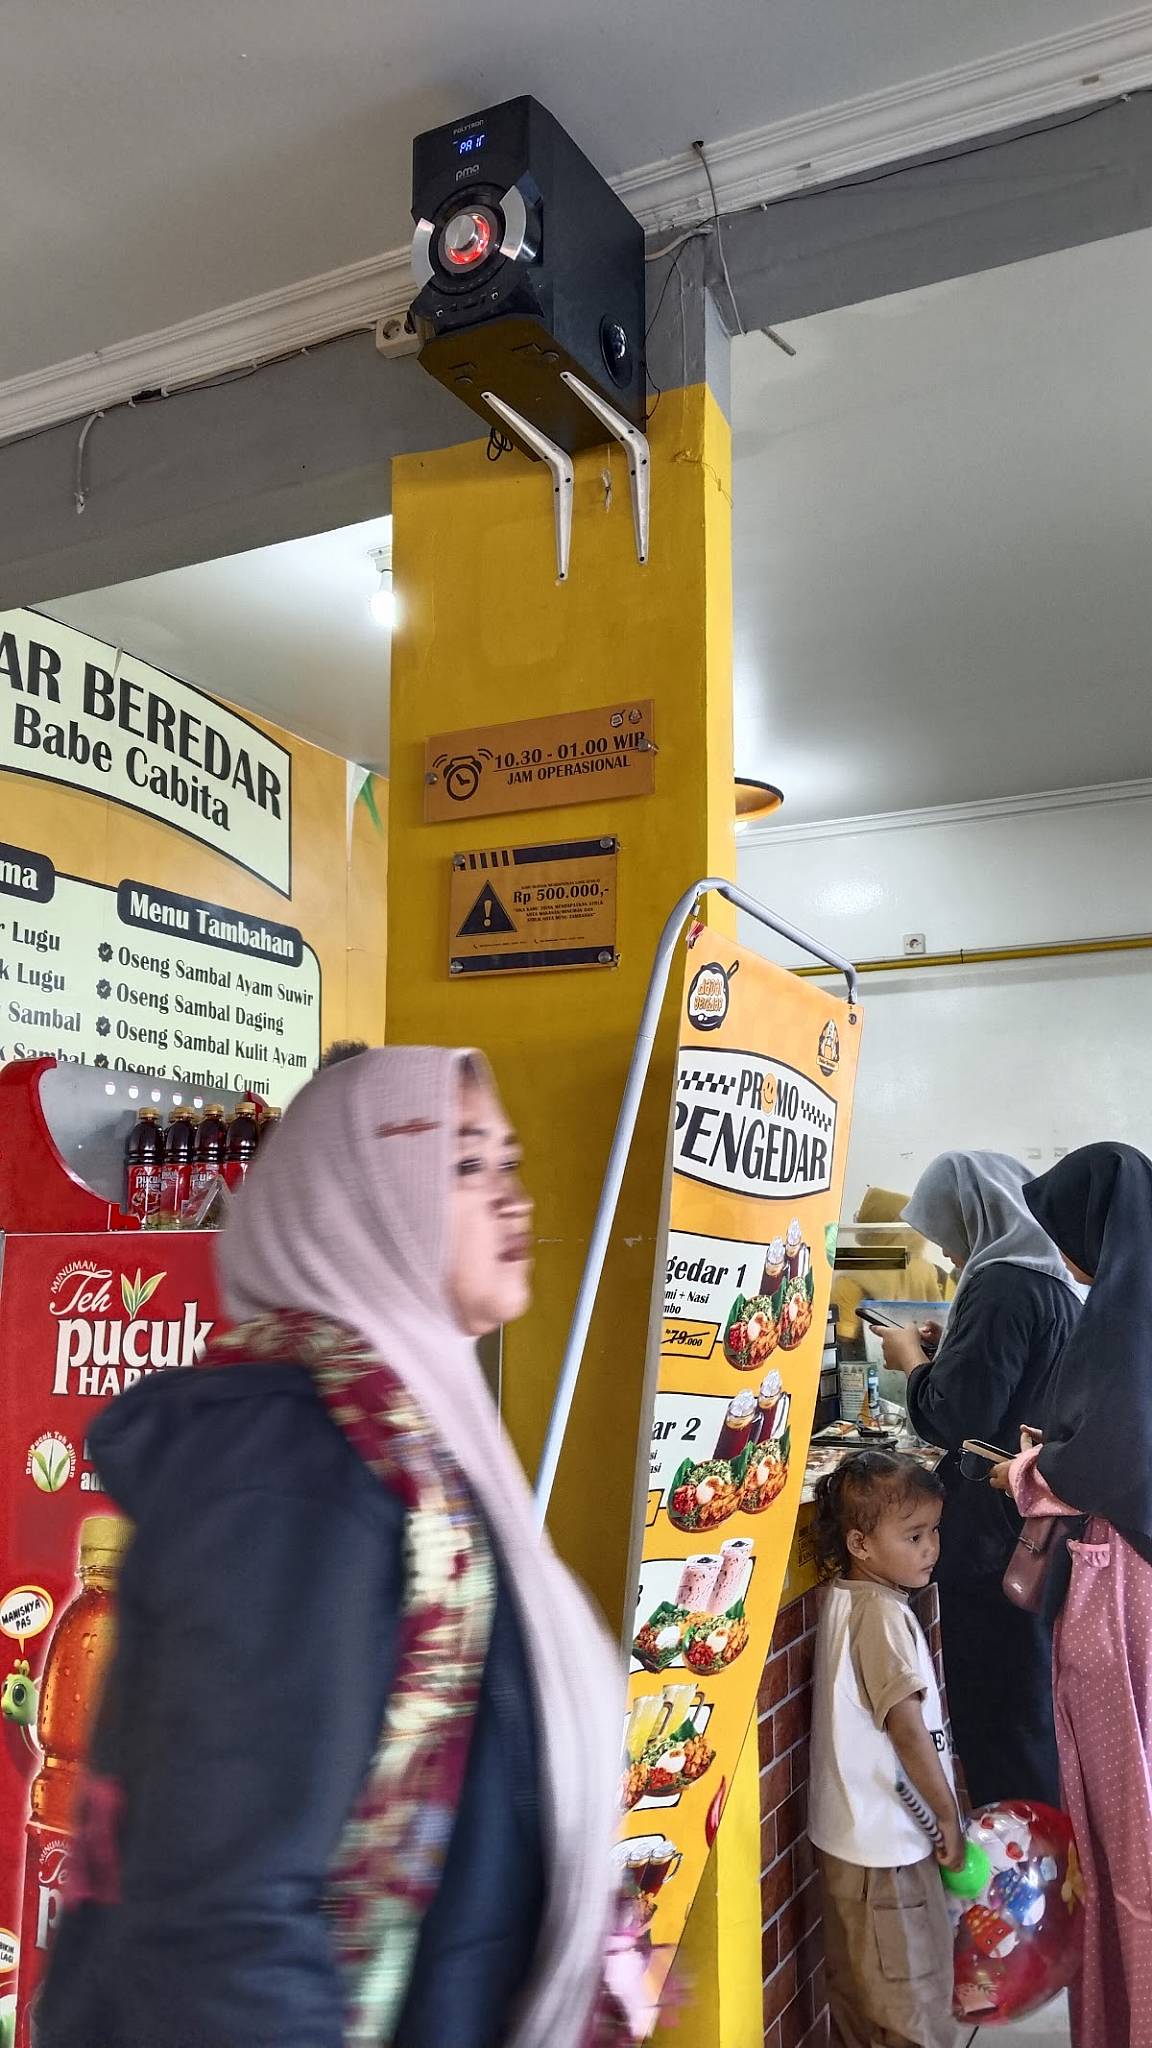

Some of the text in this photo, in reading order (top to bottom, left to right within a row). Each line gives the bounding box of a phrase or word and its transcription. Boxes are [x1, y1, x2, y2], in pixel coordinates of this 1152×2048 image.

[455, 164, 480, 181] pma
[83, 661, 282, 821] BEREDAR
[495, 748, 542, 769] 10.30
[558, 738, 608, 759] 01.00
[13, 703, 231, 832] Babe Cabita
[507, 755, 631, 786] JAM OPERASIONAL
[513, 891, 531, 905] Rp
[12, 921, 60, 953] Lugu
[130, 891, 295, 959] Menu Tambahan
[17, 962, 65, 993] Lugu
[118, 946, 314, 1006] Oseng Sambal Ayam Suwir
[8, 1001, 81, 1032] Sambal
[116, 983, 284, 1036] Oseng Sambal Daging
[116, 1020, 308, 1069] Oseng Sambal Kulit Ayam
[172, 1065, 229, 1090] Sambal
[234, 1074, 273, 1096] Cumi
[51, 1260, 97, 1294] MINUMAN
[736, 1264, 747, 1288] 1
[49, 1270, 112, 1316] Teh
[687, 1291, 711, 1304] Nasi
[53, 1301, 214, 1394] pucuk
[54, 1431, 67, 1444] Teh
[681, 1417, 702, 1441] 2
[1, 1598, 41, 1625] MANISNYA
[16, 1615, 31, 1631] PAS
